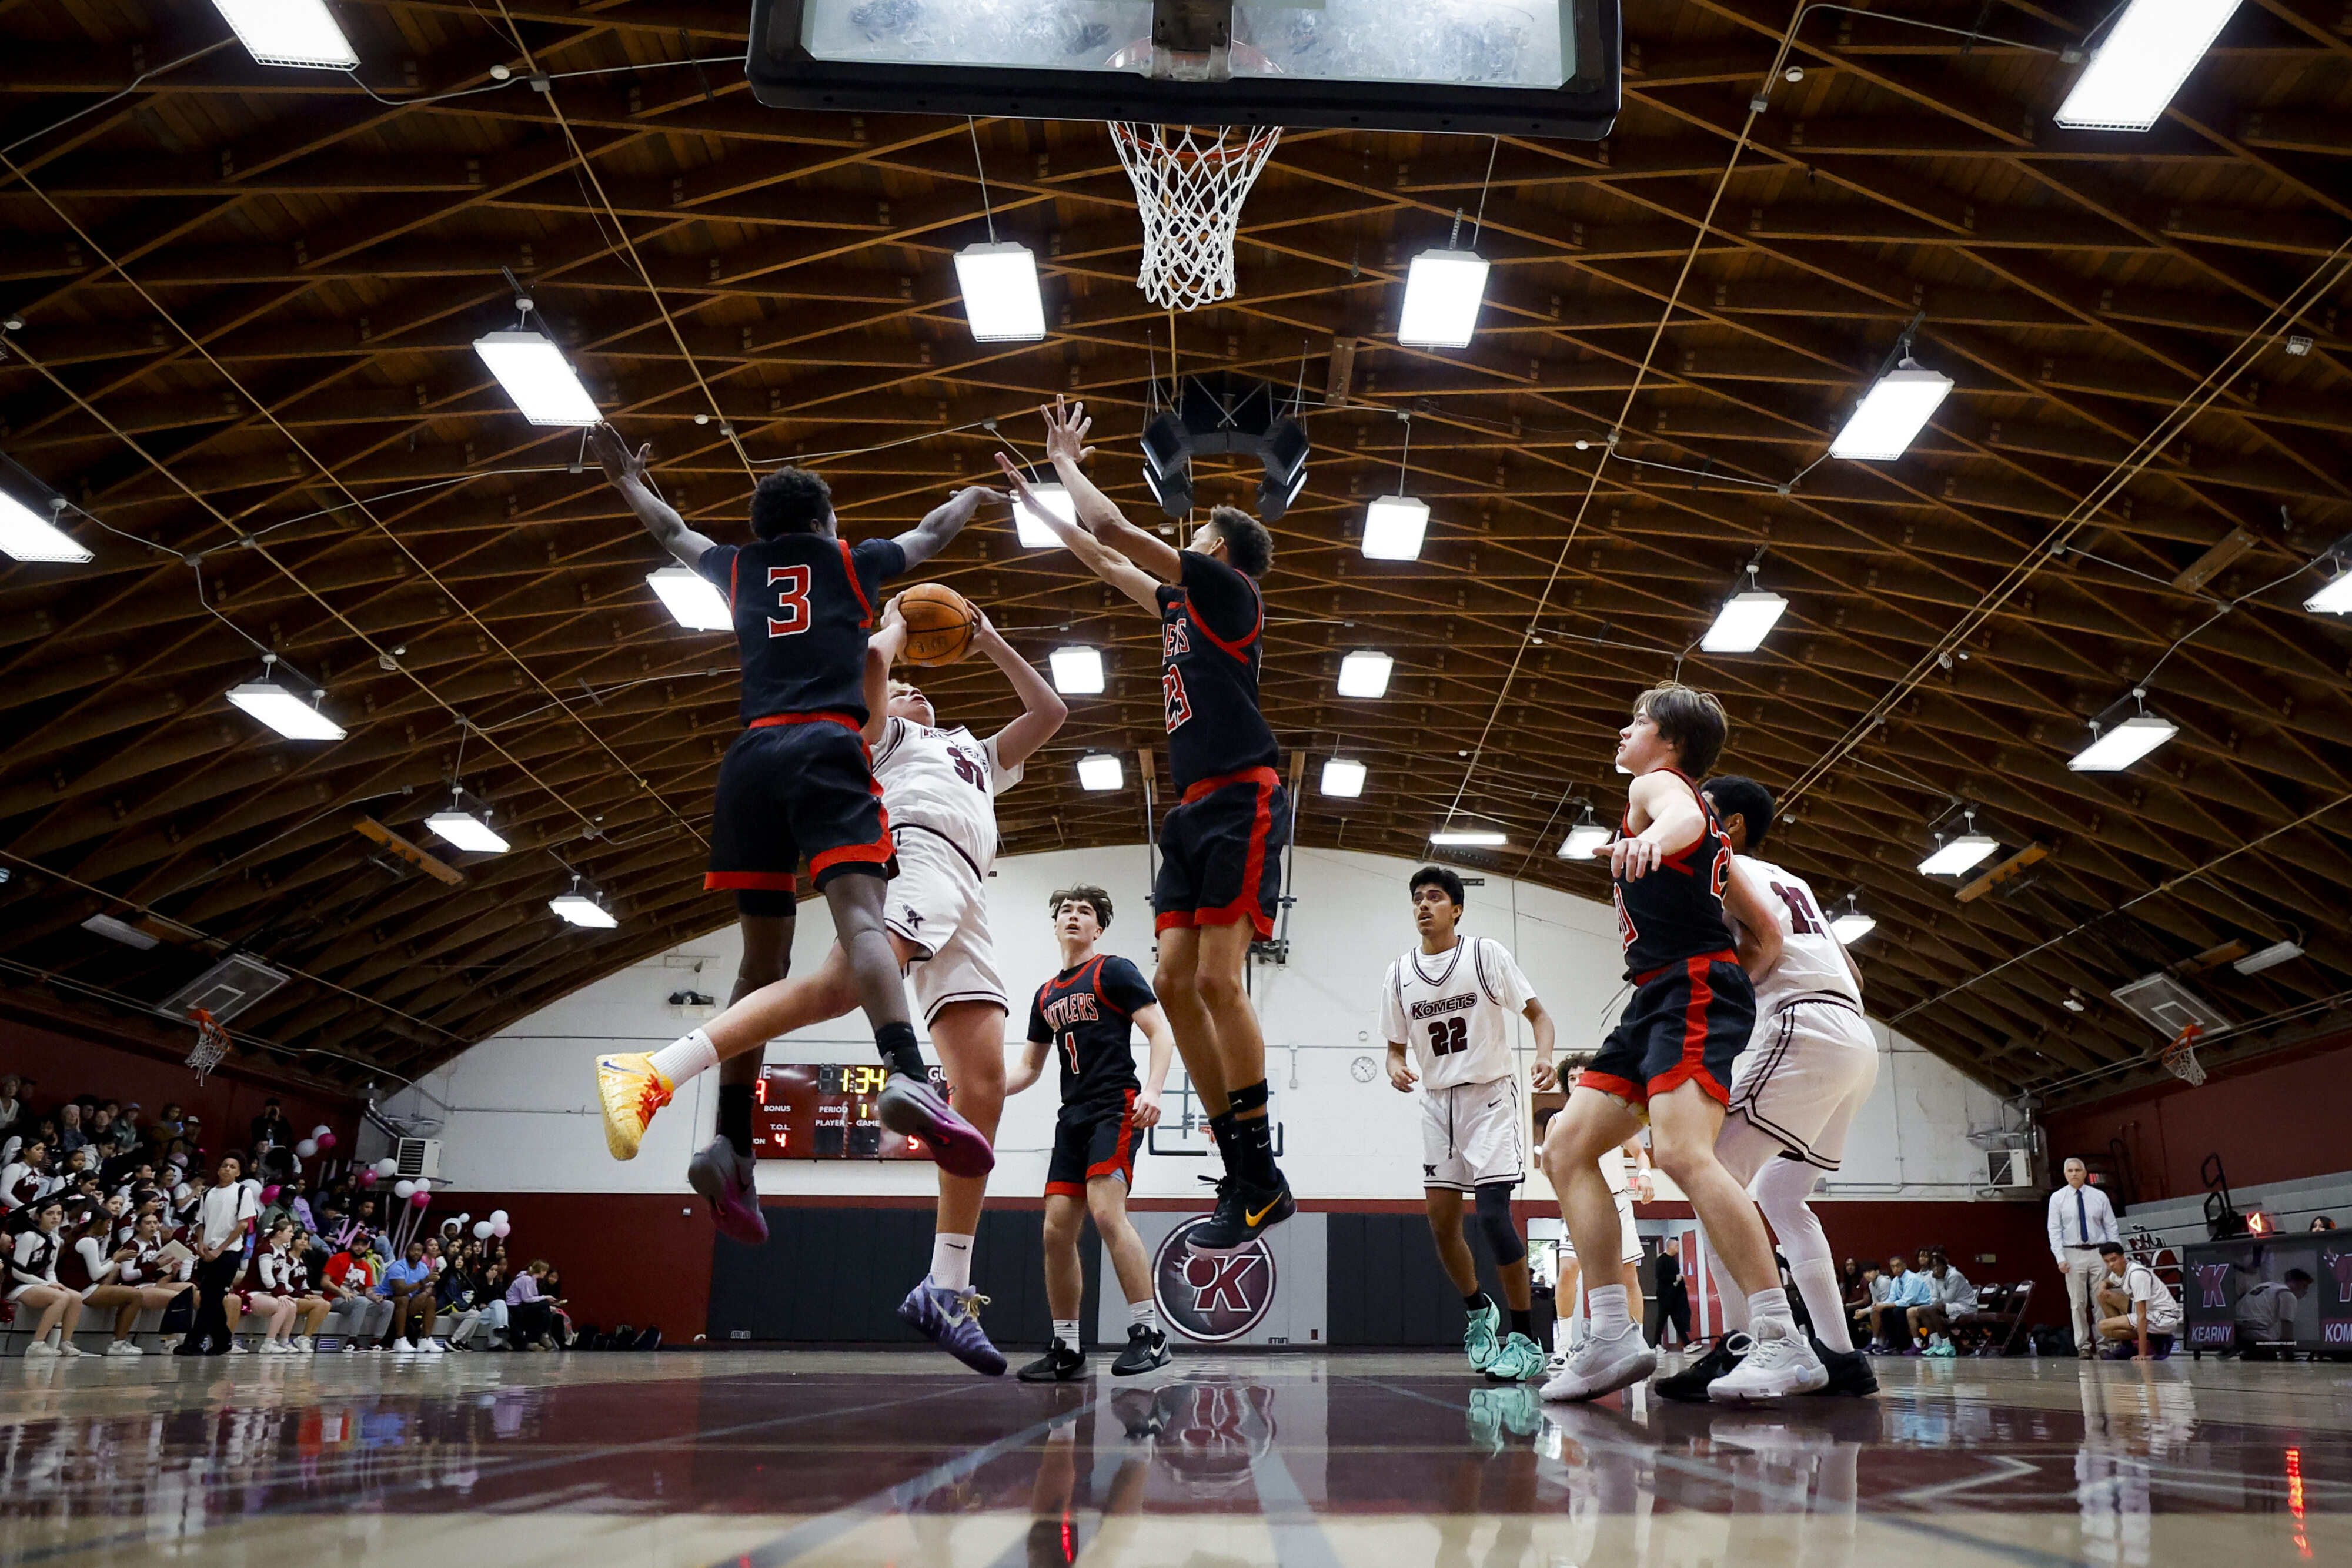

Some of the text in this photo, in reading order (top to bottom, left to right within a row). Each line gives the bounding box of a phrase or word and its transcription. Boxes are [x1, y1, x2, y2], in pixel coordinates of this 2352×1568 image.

[767, 564, 811, 639] 3
[1162, 663, 1192, 735] 23
[1410, 992, 1478, 1021] KOMETS
[1065, 1031, 1080, 1075] 1
[1428, 1017, 1468, 1057] 22
[861, 1103, 868, 1118] 1
[774, 1133, 787, 1148] 4
[2191, 1326, 2232, 1342] KEARNY
